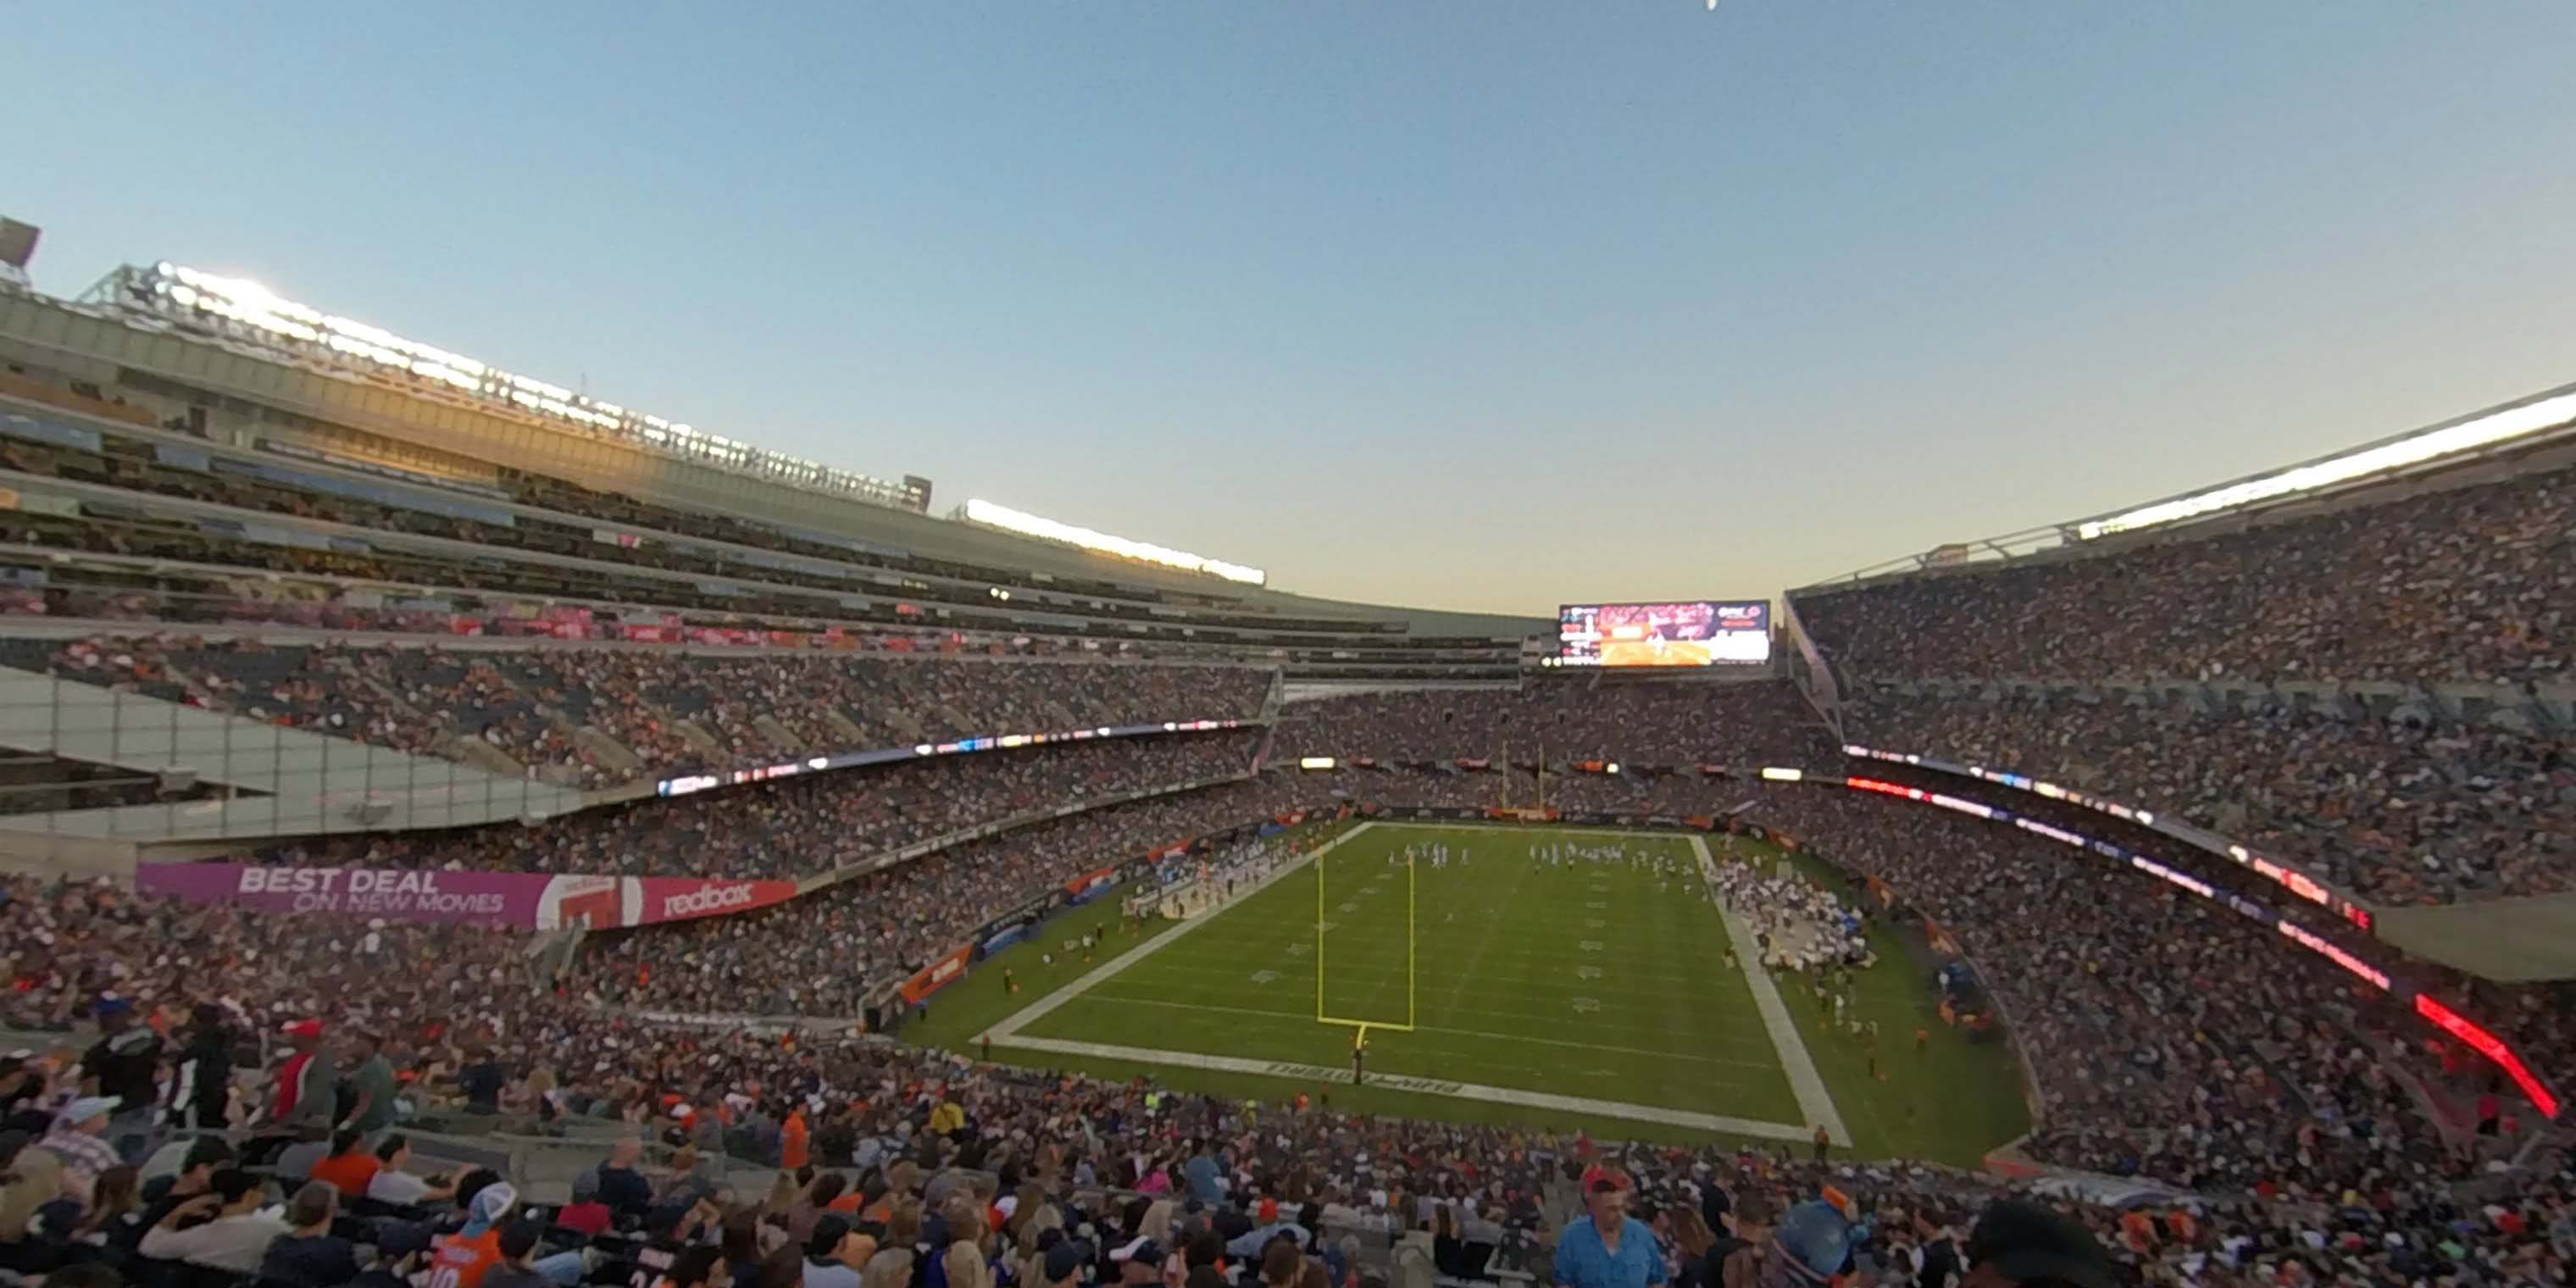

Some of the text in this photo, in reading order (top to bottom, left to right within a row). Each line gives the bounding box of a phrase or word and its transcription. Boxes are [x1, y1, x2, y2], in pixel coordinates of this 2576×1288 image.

[239, 867, 439, 895] BEST DEAL
[292, 891, 505, 913] ON NEW MOVIES
[663, 882, 753, 917] redbox
